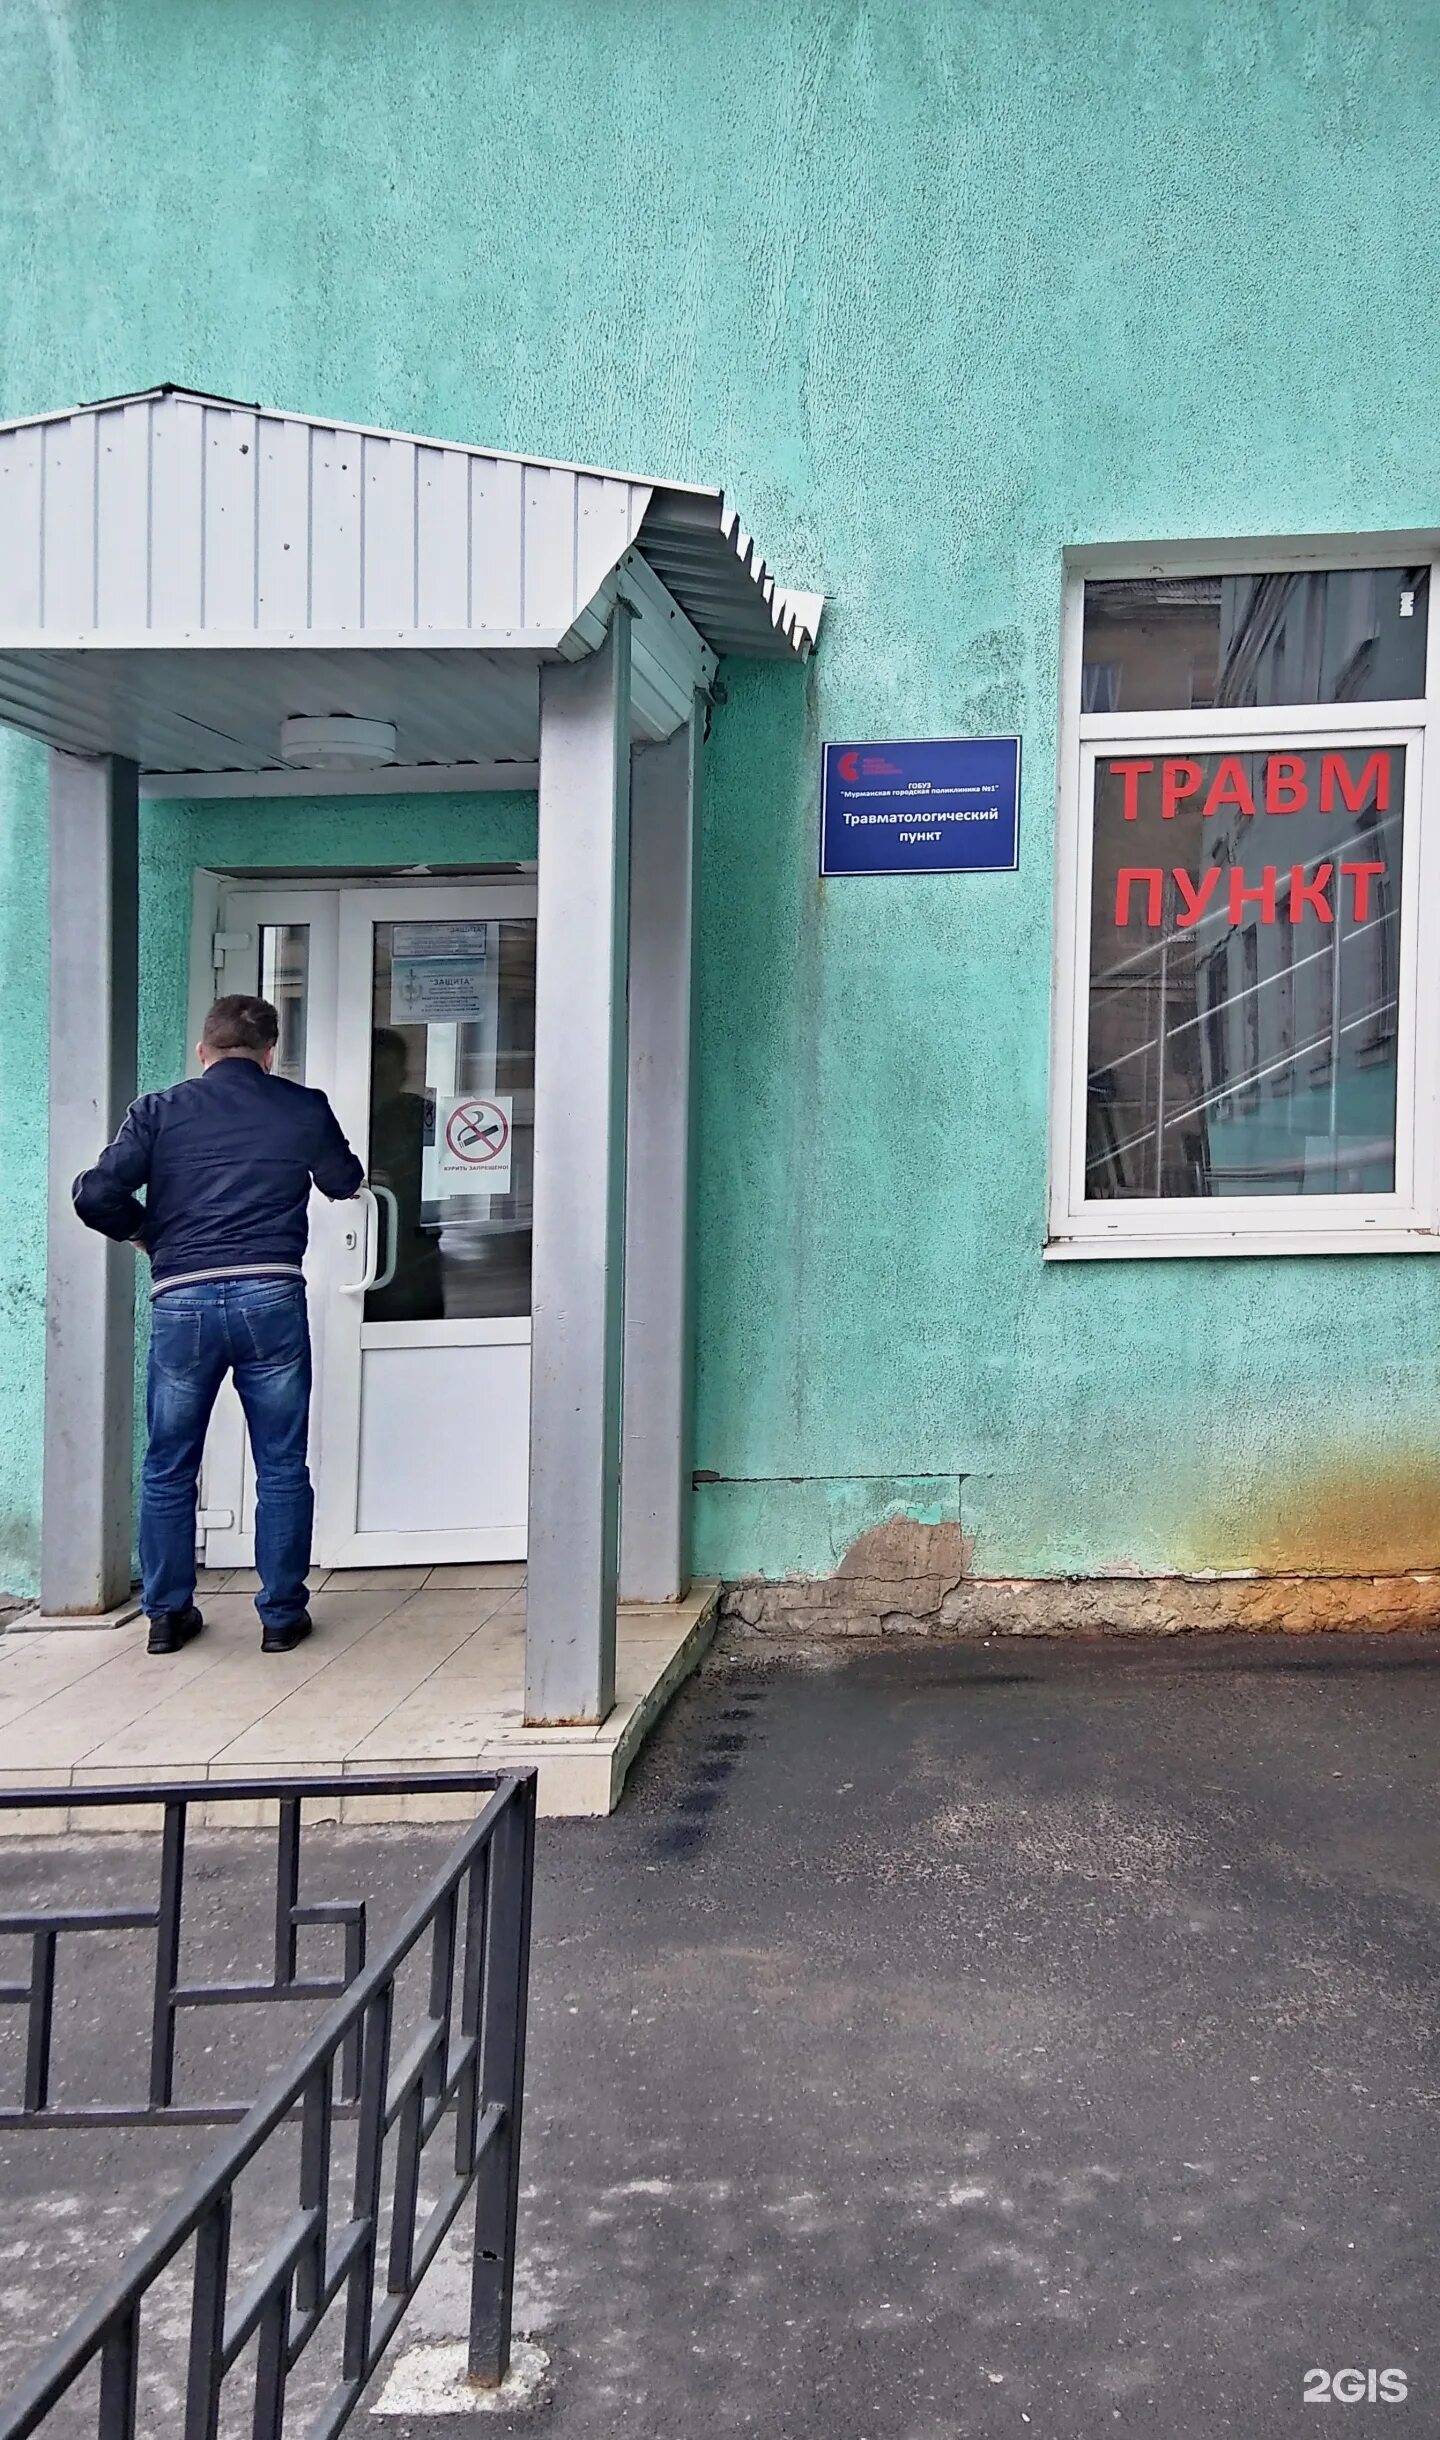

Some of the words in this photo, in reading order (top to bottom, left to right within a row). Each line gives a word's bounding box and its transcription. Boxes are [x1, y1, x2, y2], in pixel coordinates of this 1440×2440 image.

[840, 790, 891, 799] "Мурманская
[892, 788, 930, 797] городская
[931, 786, 980, 795] поликлиника
[908, 782, 931, 790] ГОБУЗ
[1109, 751, 1391, 821] ТРАВМ
[843, 807, 999, 827] Травматологический
[899, 831, 942, 844] пункт
[1114, 862, 1387, 927] ПУНКТ
